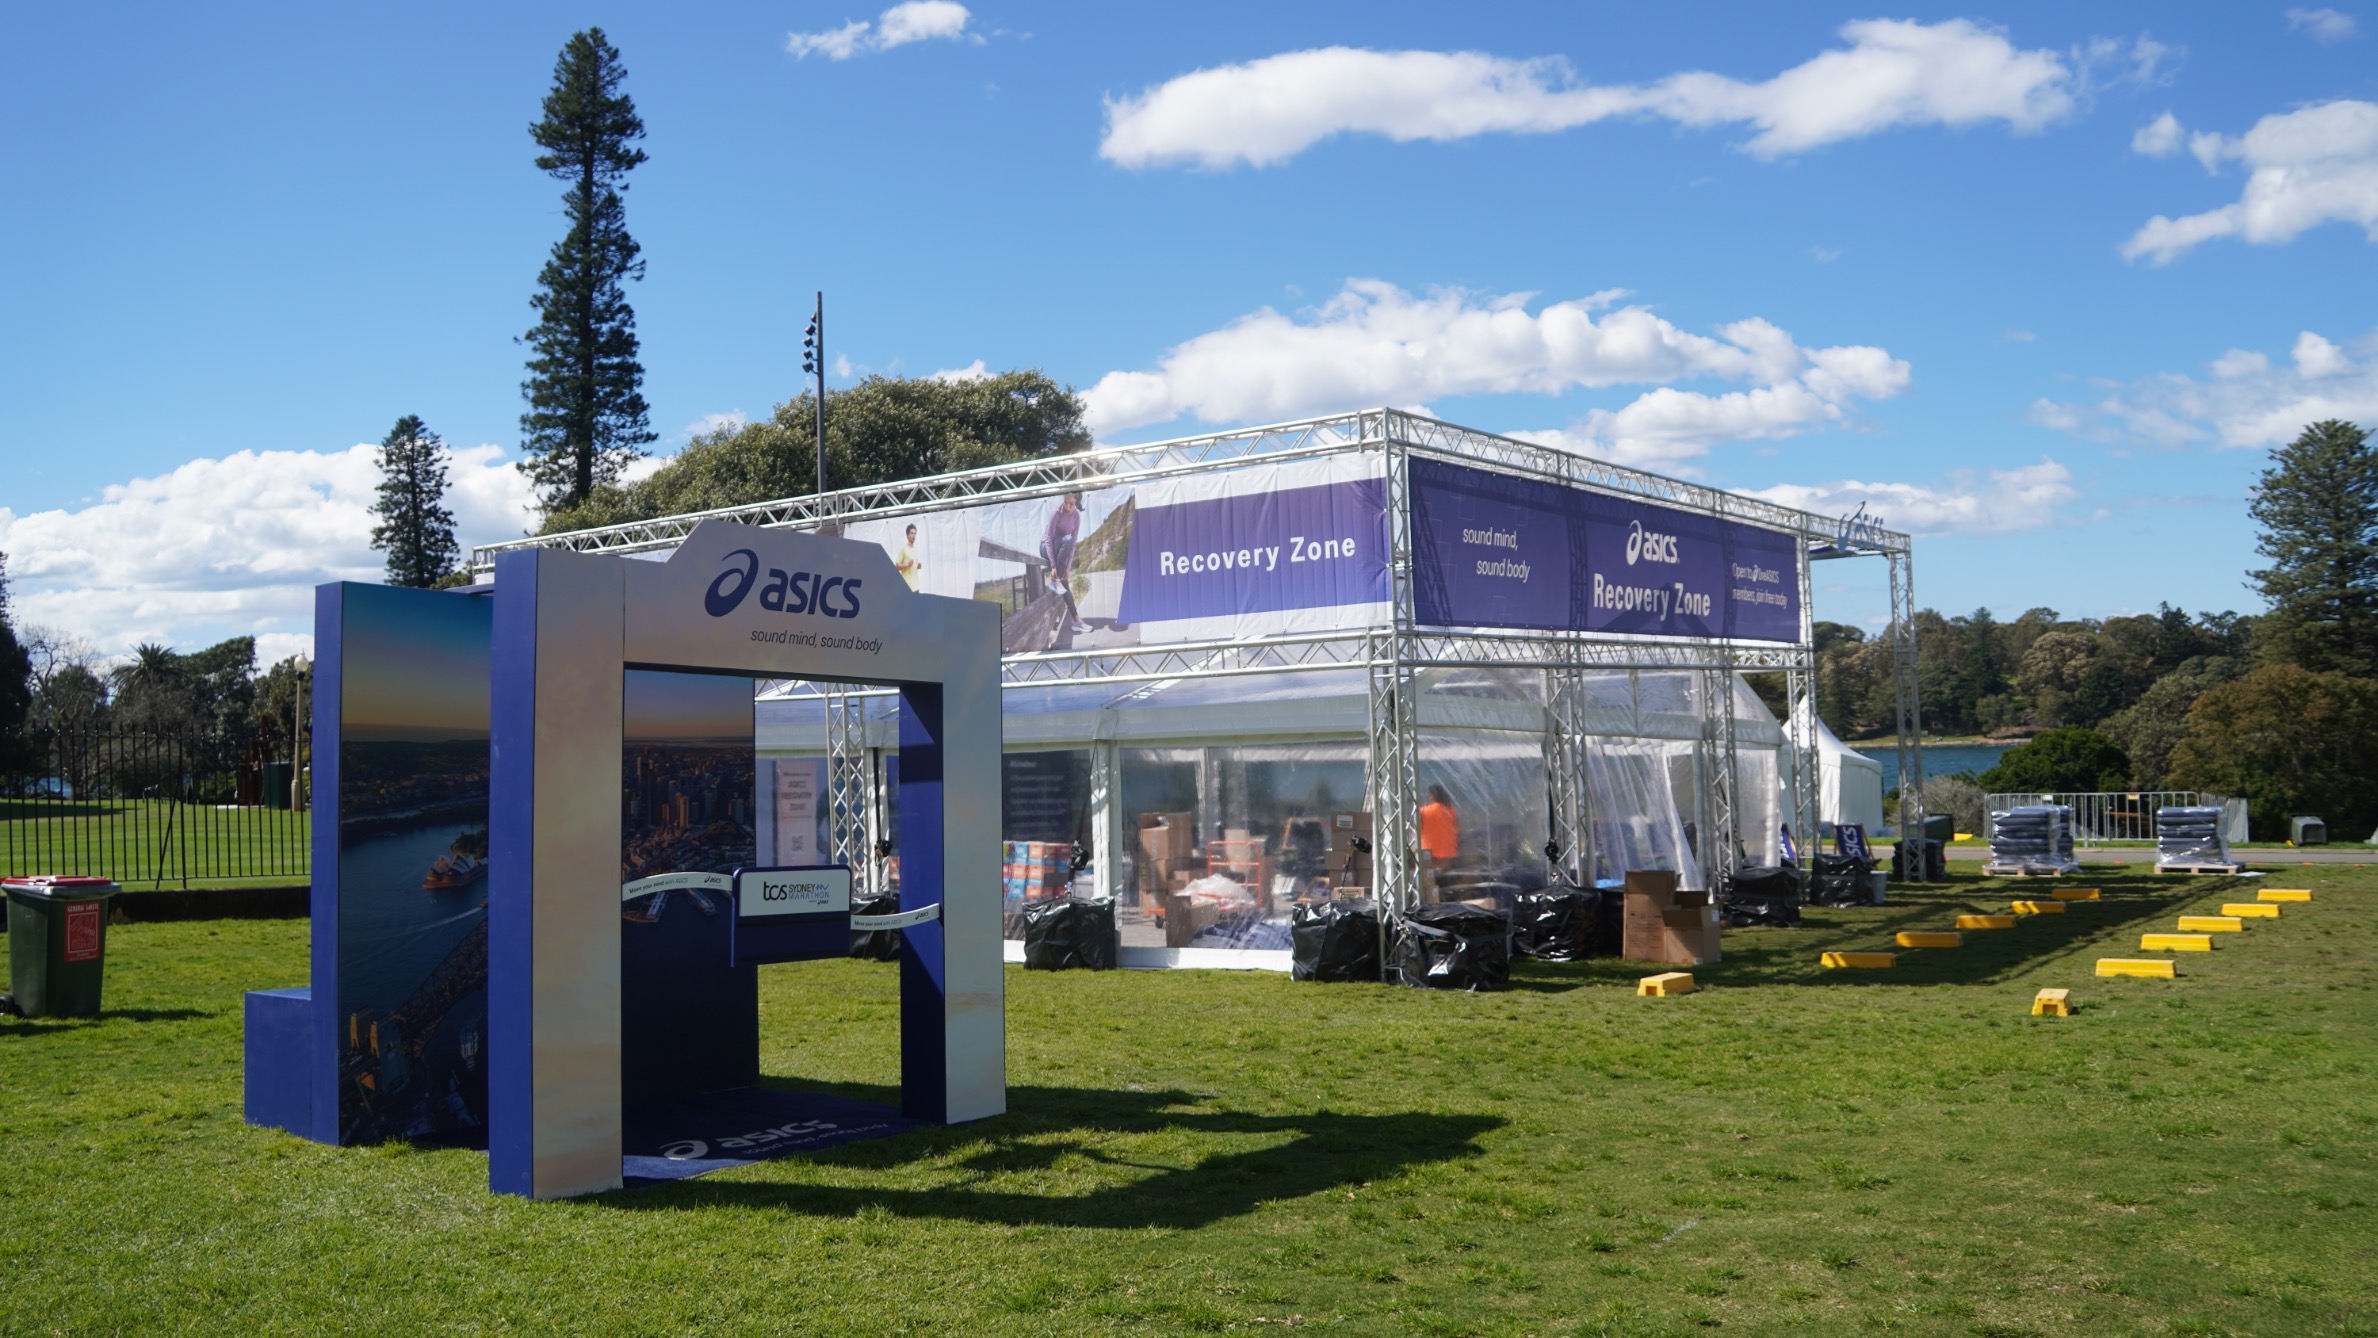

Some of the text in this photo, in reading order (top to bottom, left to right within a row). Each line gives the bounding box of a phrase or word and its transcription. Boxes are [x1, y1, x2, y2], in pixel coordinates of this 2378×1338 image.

[1463, 527, 1518, 551] sound mind,
[1160, 536, 1356, 576] Recovery Zone
[1476, 558, 1531, 583] sound body
[1593, 572, 1711, 621] Recovery Zone
[751, 629, 883, 655] sound mind, sound body
[629, 886, 642, 894] Move
[763, 881, 816, 901] tcs SYDNEY
[788, 892, 830, 900] MARATHON
